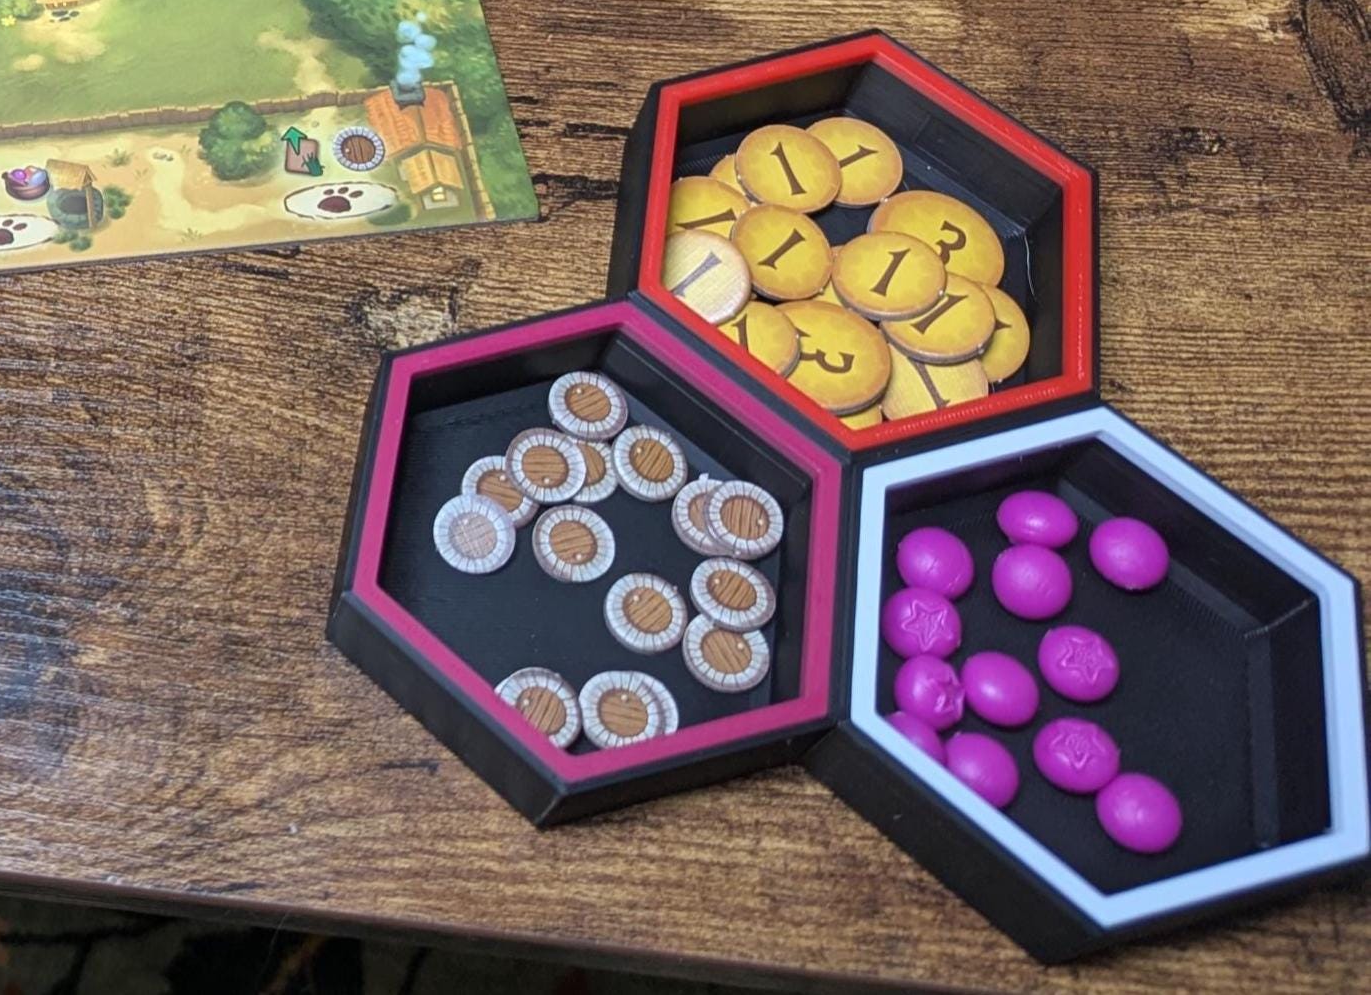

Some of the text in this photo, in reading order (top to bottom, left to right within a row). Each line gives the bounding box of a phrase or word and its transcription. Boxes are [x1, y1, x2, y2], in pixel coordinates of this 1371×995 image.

[770, 141, 807, 196] 1
[674, 207, 738, 230] 1
[757, 228, 806, 271] 1
[670, 251, 723, 297] 1
[869, 248, 912, 297] 1
[909, 293, 969, 335] 1
